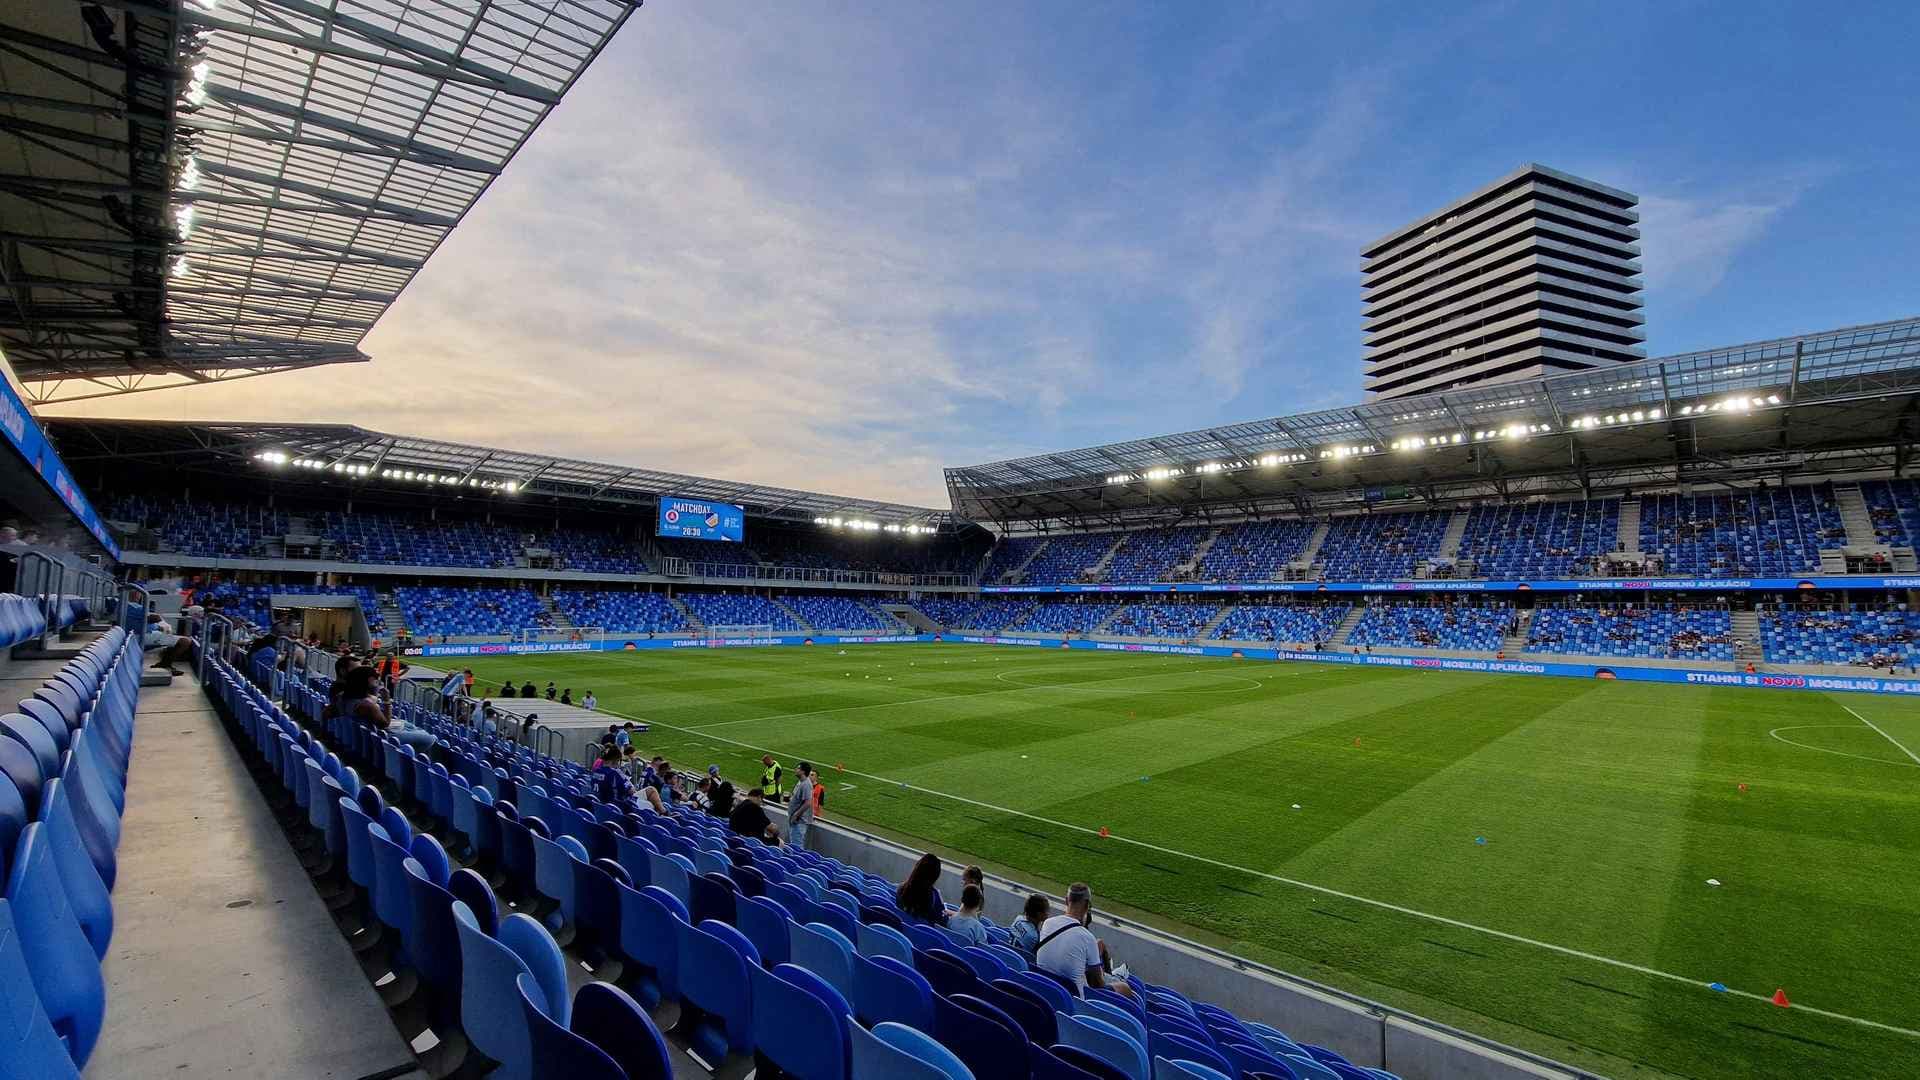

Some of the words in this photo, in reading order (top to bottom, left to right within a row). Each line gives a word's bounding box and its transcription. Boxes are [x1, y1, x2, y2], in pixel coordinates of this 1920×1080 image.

[673, 502, 711, 515] MATCHDAY
[682, 527, 701, 536] 20:30
[1686, 673, 1742, 684] STIAHNI
[1745, 675, 1759, 685] SI
[1808, 679, 1879, 691] MOBILNÚ
